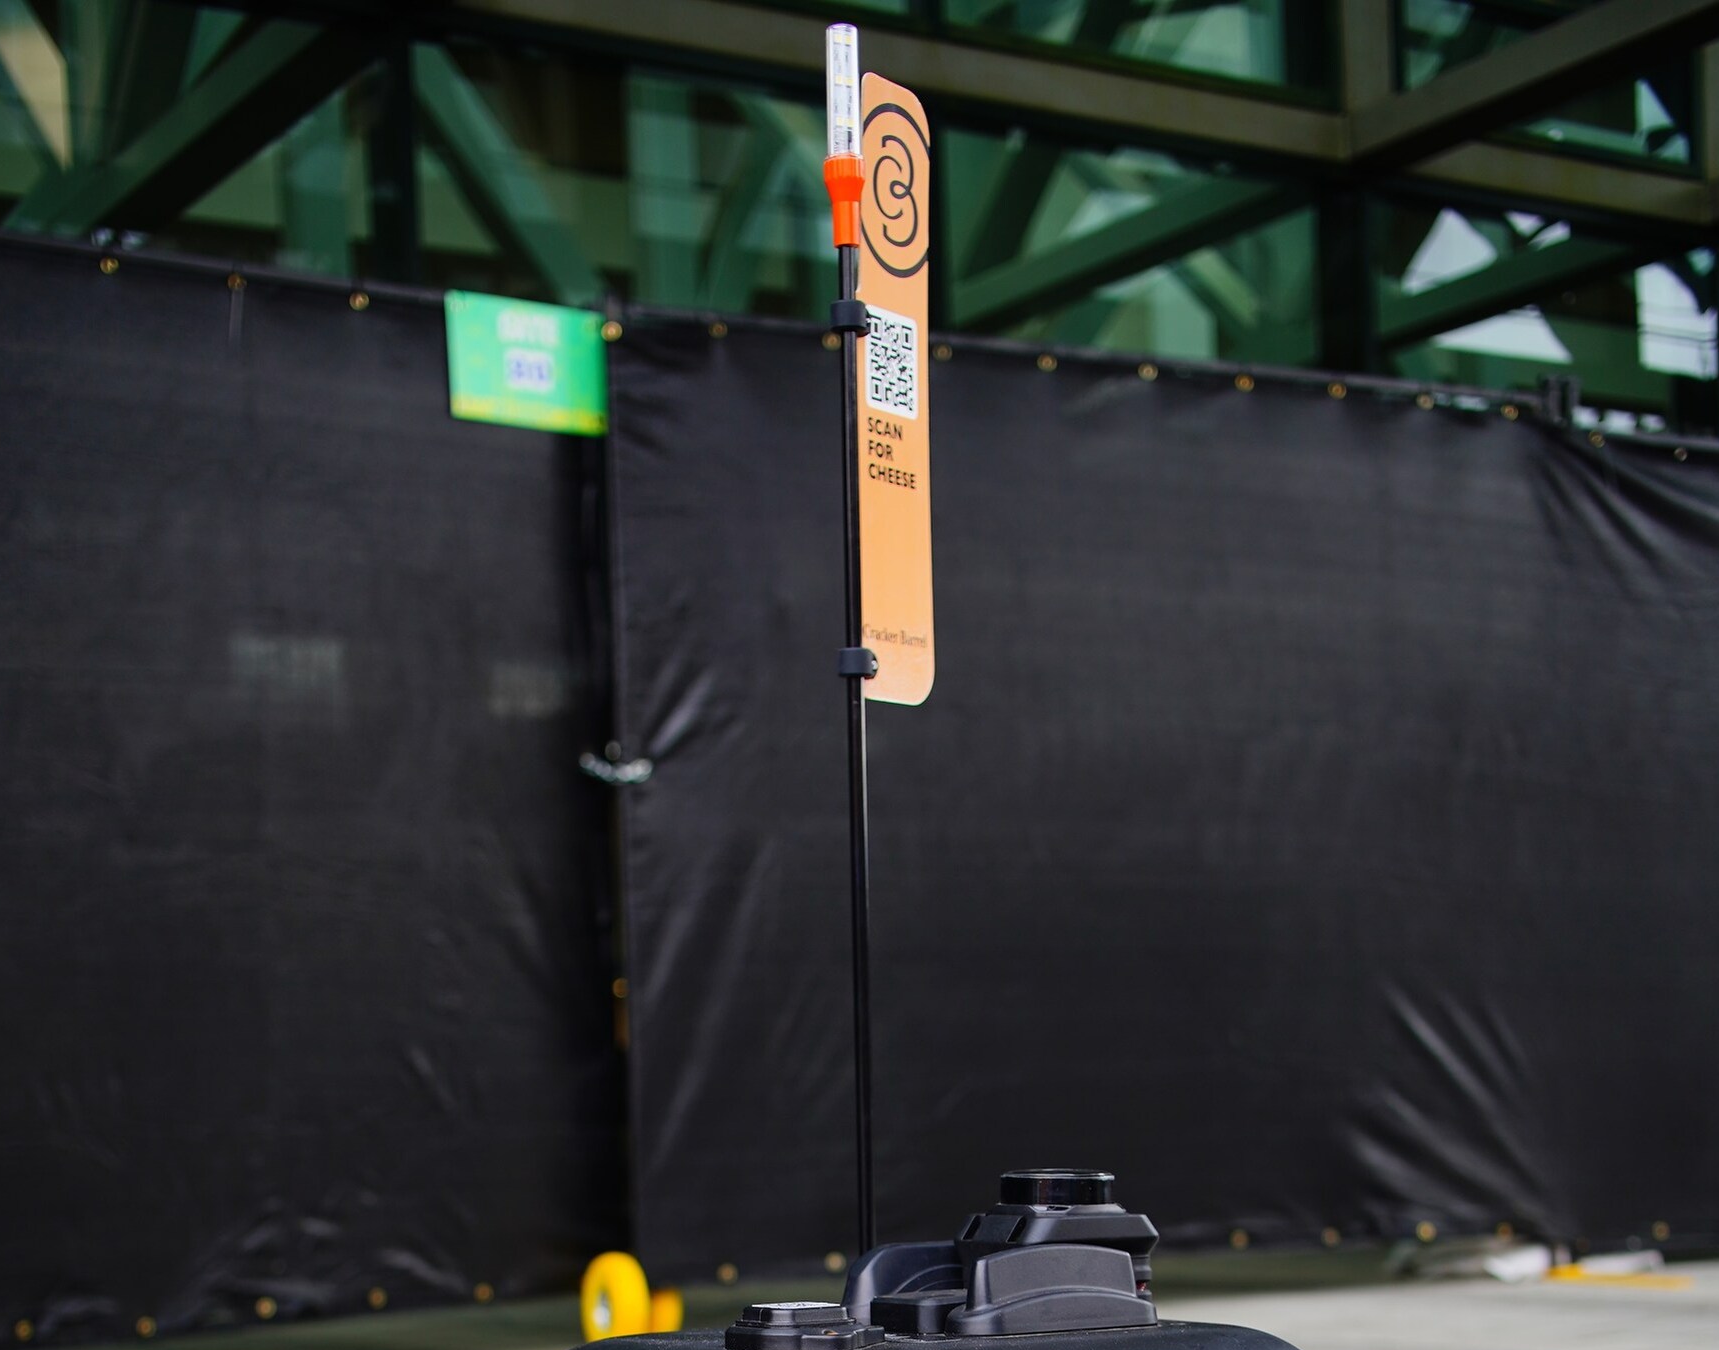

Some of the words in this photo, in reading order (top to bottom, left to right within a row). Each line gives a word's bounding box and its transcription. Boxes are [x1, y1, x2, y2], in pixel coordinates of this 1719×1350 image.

[867, 416, 902, 440] SCAN
[867, 440, 894, 461] FOR
[868, 463, 917, 490] CHEESE
